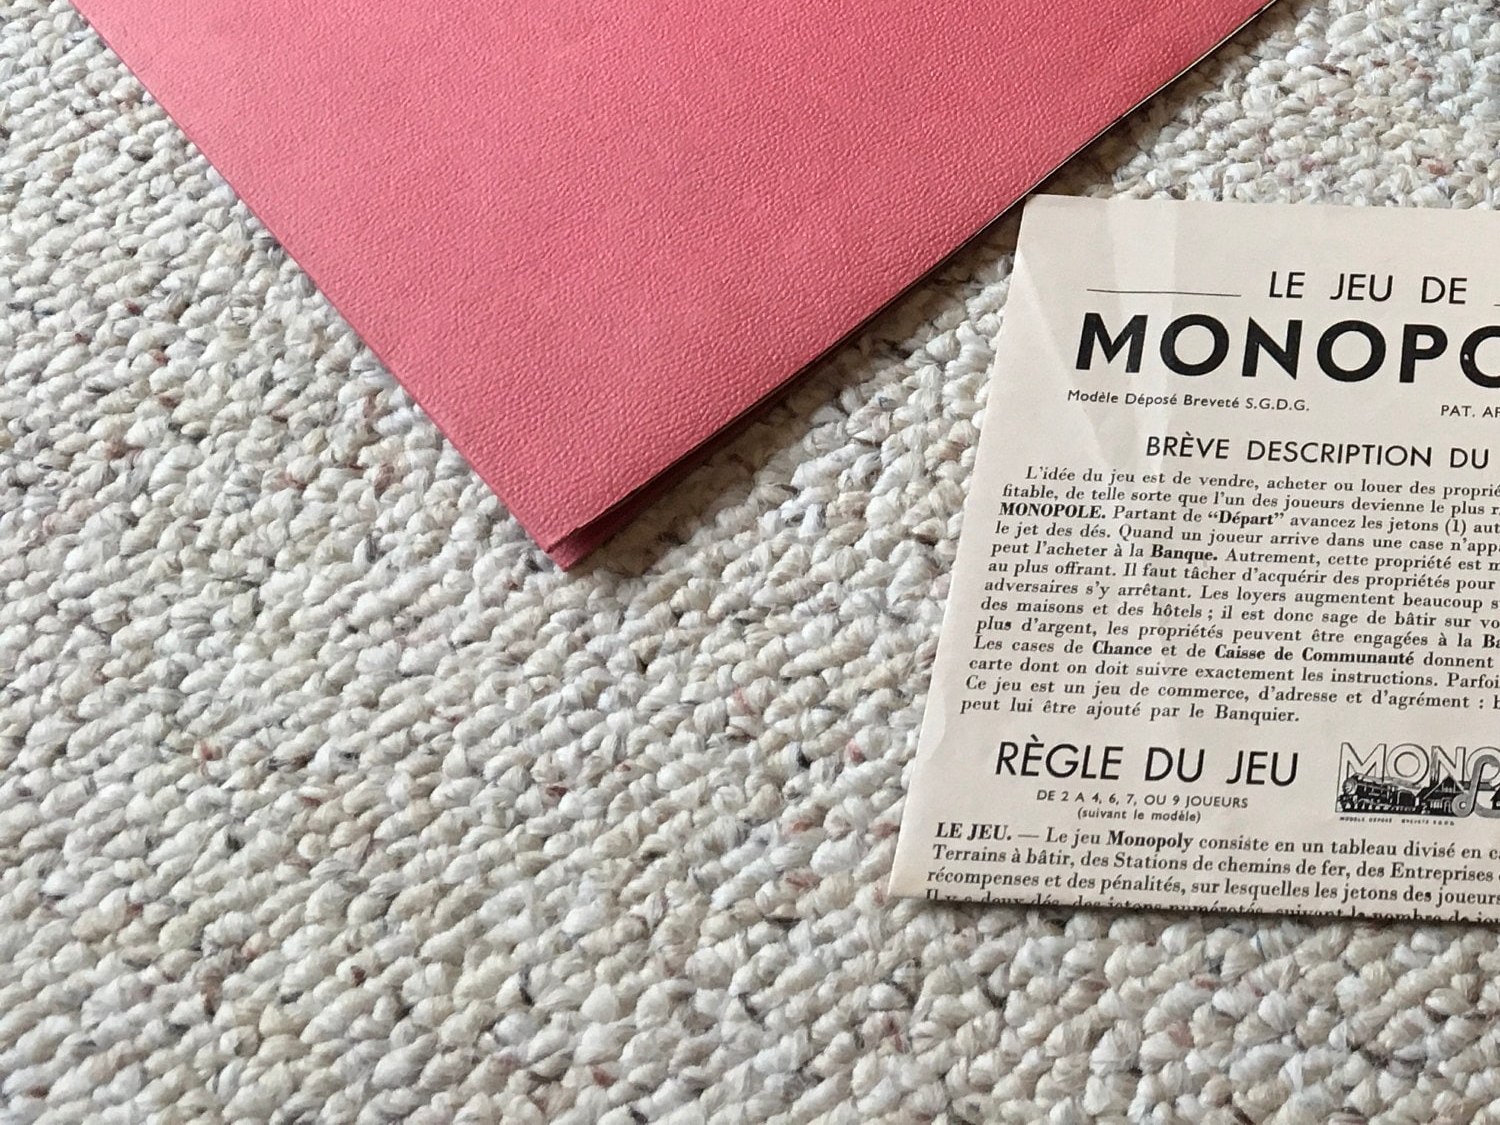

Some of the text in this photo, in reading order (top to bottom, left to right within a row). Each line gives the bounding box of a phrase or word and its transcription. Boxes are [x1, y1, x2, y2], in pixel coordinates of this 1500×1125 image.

[1269, 271, 1468, 305] LE JEU DE
[1067, 389, 1310, 412] Modèle Déposé Breveté S.G.D.G.
[1440, 404, 1476, 418] PAT.
[1146, 431, 1230, 460] BRÈVE
[1247, 440, 1432, 467] DESCRIPTION
[1450, 447, 1489, 470] DU
[1025, 466, 1076, 481] L'idée
[1082, 468, 1103, 482] du
[1108, 468, 1135, 486] jeu
[1142, 473, 1166, 484] est
[1172, 470, 1192, 485] de
[1198, 473, 1259, 491] vendre,
[1266, 476, 1328, 491] acheter
[1334, 482, 1354, 491] ou
[1360, 478, 1403, 494] louer
[1409, 480, 1436, 495] des
[995, 733, 1299, 787] RÈGLE DU JEU
[1036, 789, 1248, 809] DE 2 A 4, 6, 7, OU 9 JOUEURS
[1077, 806, 1201, 824] (suivant le modèle)
[935, 822, 963, 839] LE
[966, 823, 1012, 841] JEU.
[1045, 826, 1068, 843] Le
[1070, 828, 1101, 849] jeu
[1105, 830, 1194, 854] Monopoly
[1199, 834, 1269, 852] consiste
[1275, 841, 1295, 852] en
[1302, 842, 1324, 853] un
[1331, 838, 1397, 856] tableau
[1403, 840, 1455, 858] divisé
[1461, 848, 1482, 859] en
